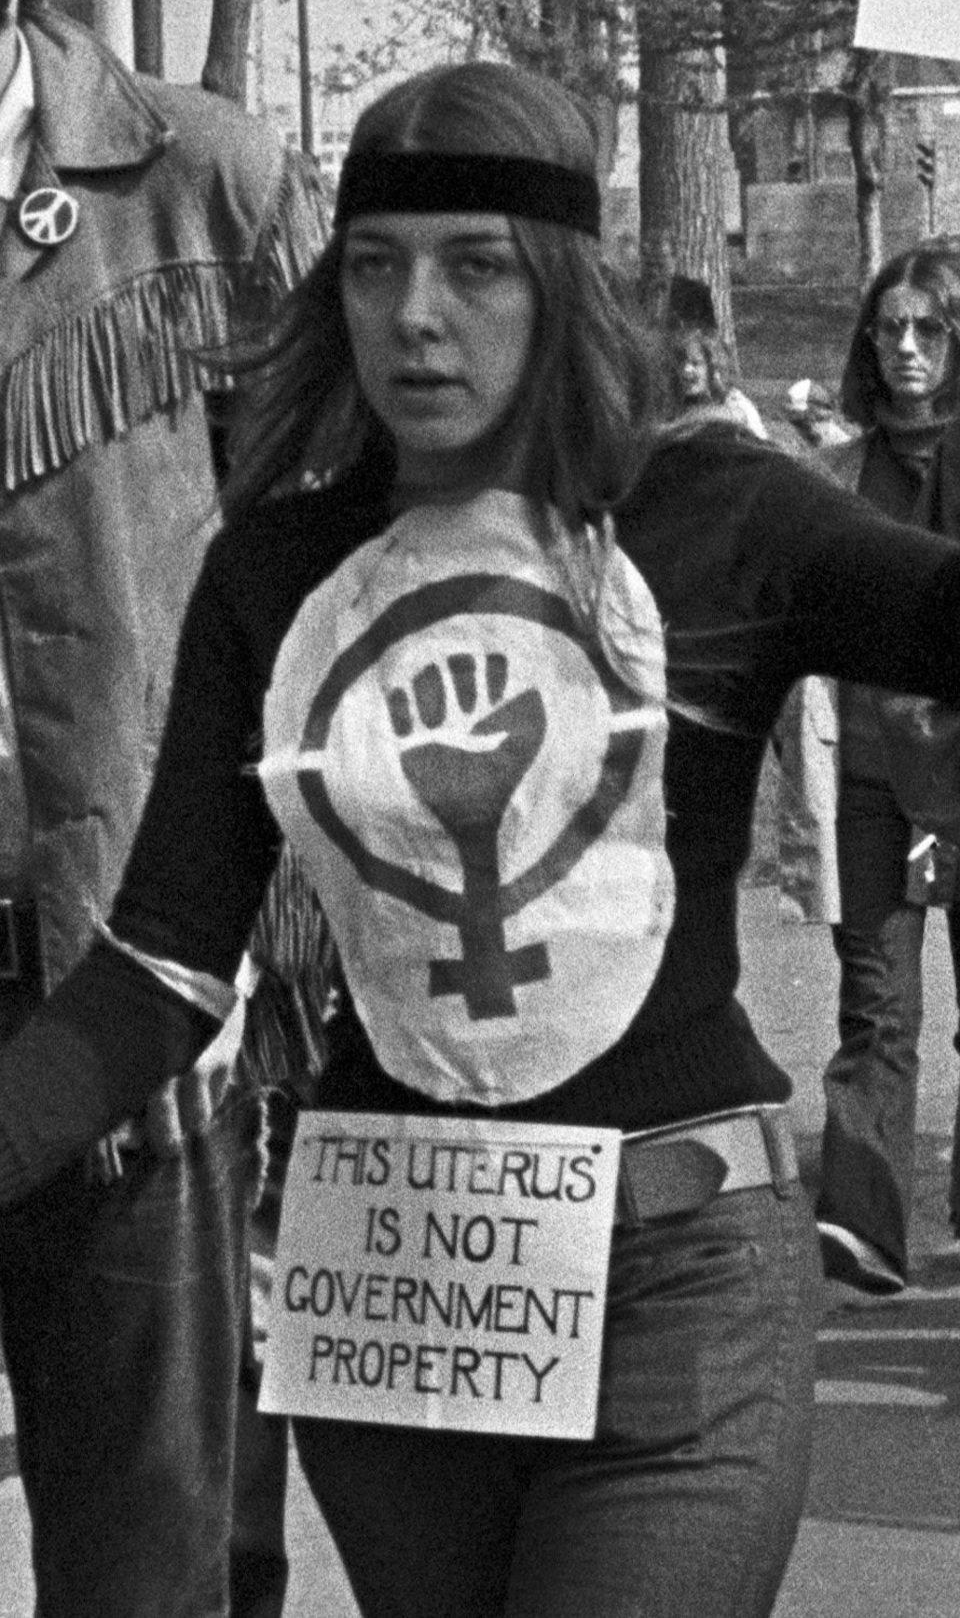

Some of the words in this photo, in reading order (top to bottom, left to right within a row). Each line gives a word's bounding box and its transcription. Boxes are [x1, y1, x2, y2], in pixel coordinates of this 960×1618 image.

[312, 1135, 391, 1186] THIS
[407, 1143, 597, 1203] UTERUS
[365, 1206, 402, 1256] IS
[423, 1211, 539, 1266] NOT
[284, 1265, 596, 1339] GOVERNMENT
[308, 1334, 561, 1403] PROPERTY
